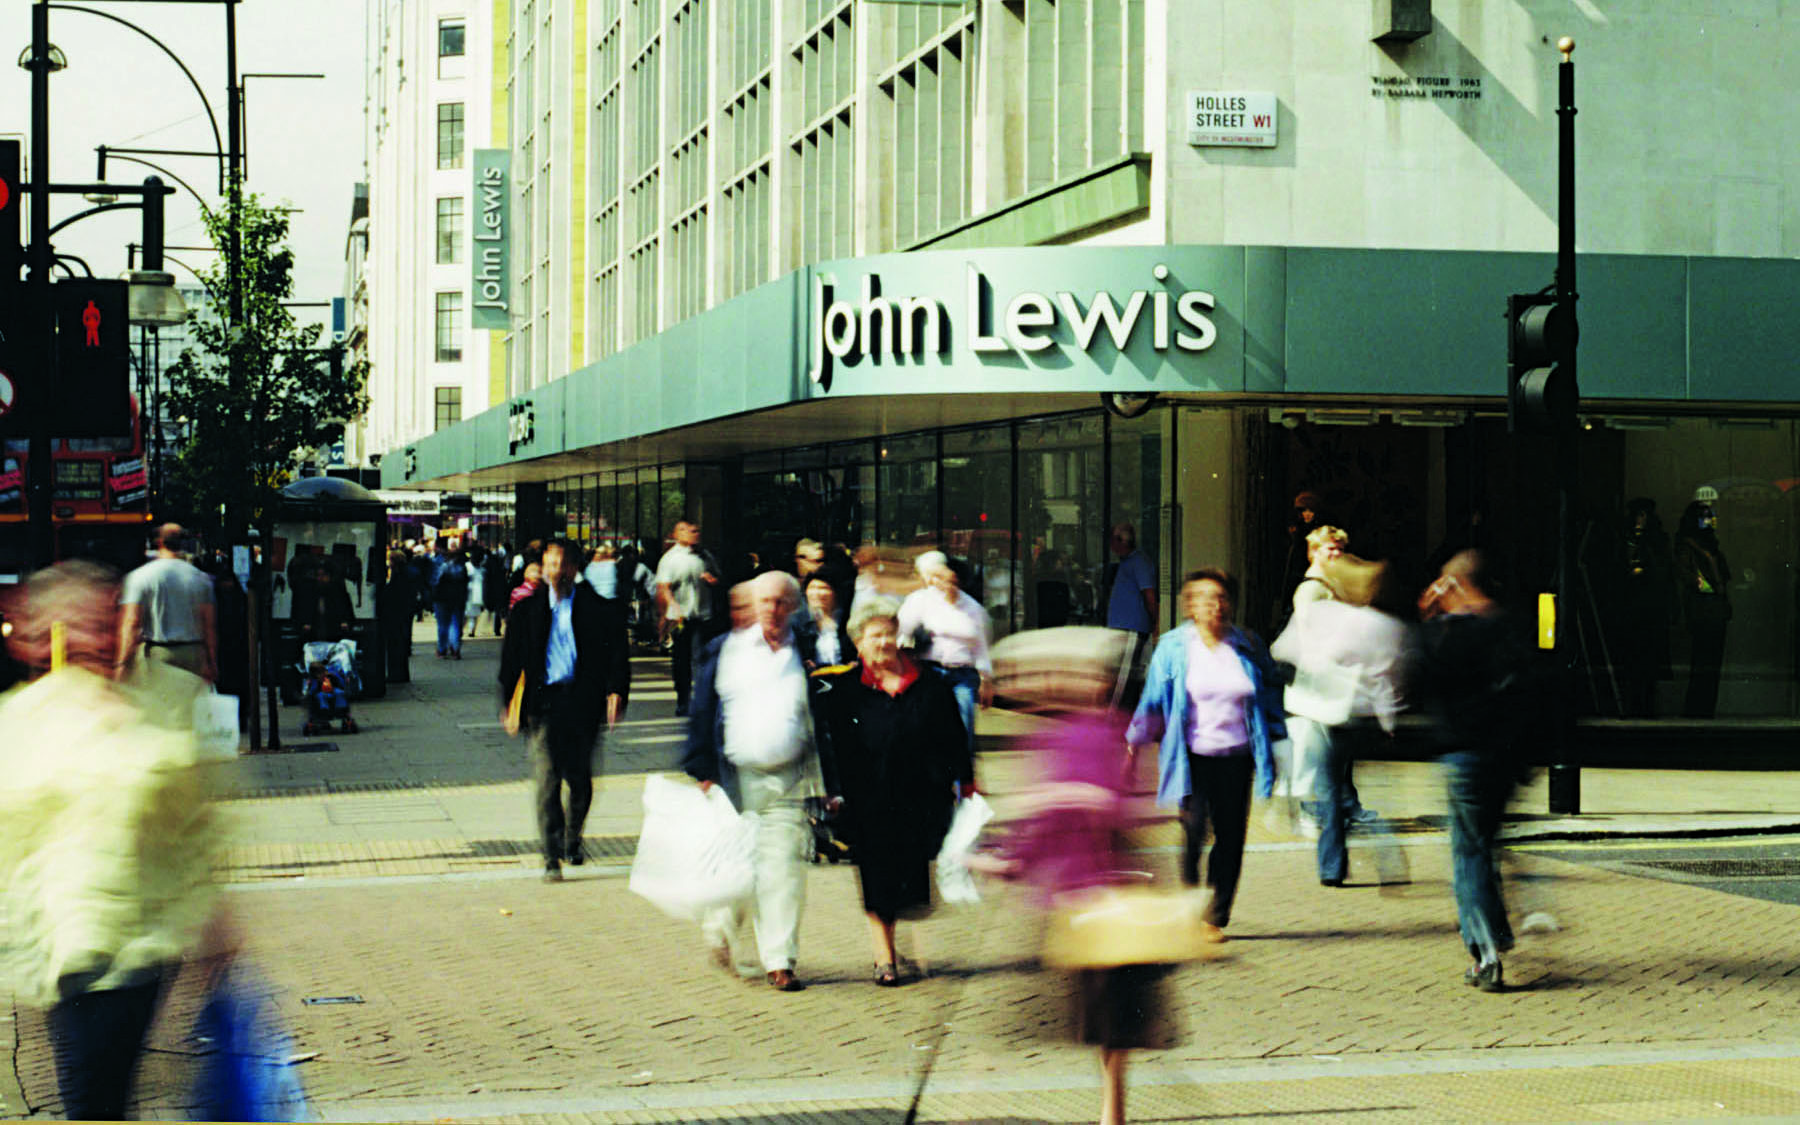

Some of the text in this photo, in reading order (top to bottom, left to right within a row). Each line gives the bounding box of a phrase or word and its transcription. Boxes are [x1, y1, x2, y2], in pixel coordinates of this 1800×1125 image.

[1416, 77, 1450, 86] FIGURE
[1431, 90, 1481, 99] HEPWORTH
[1196, 96, 1246, 111] HOLLES
[1196, 113, 1271, 128] STREET W1
[474, 167, 508, 312] John Lewis
[810, 261, 1218, 384] John Lewis
